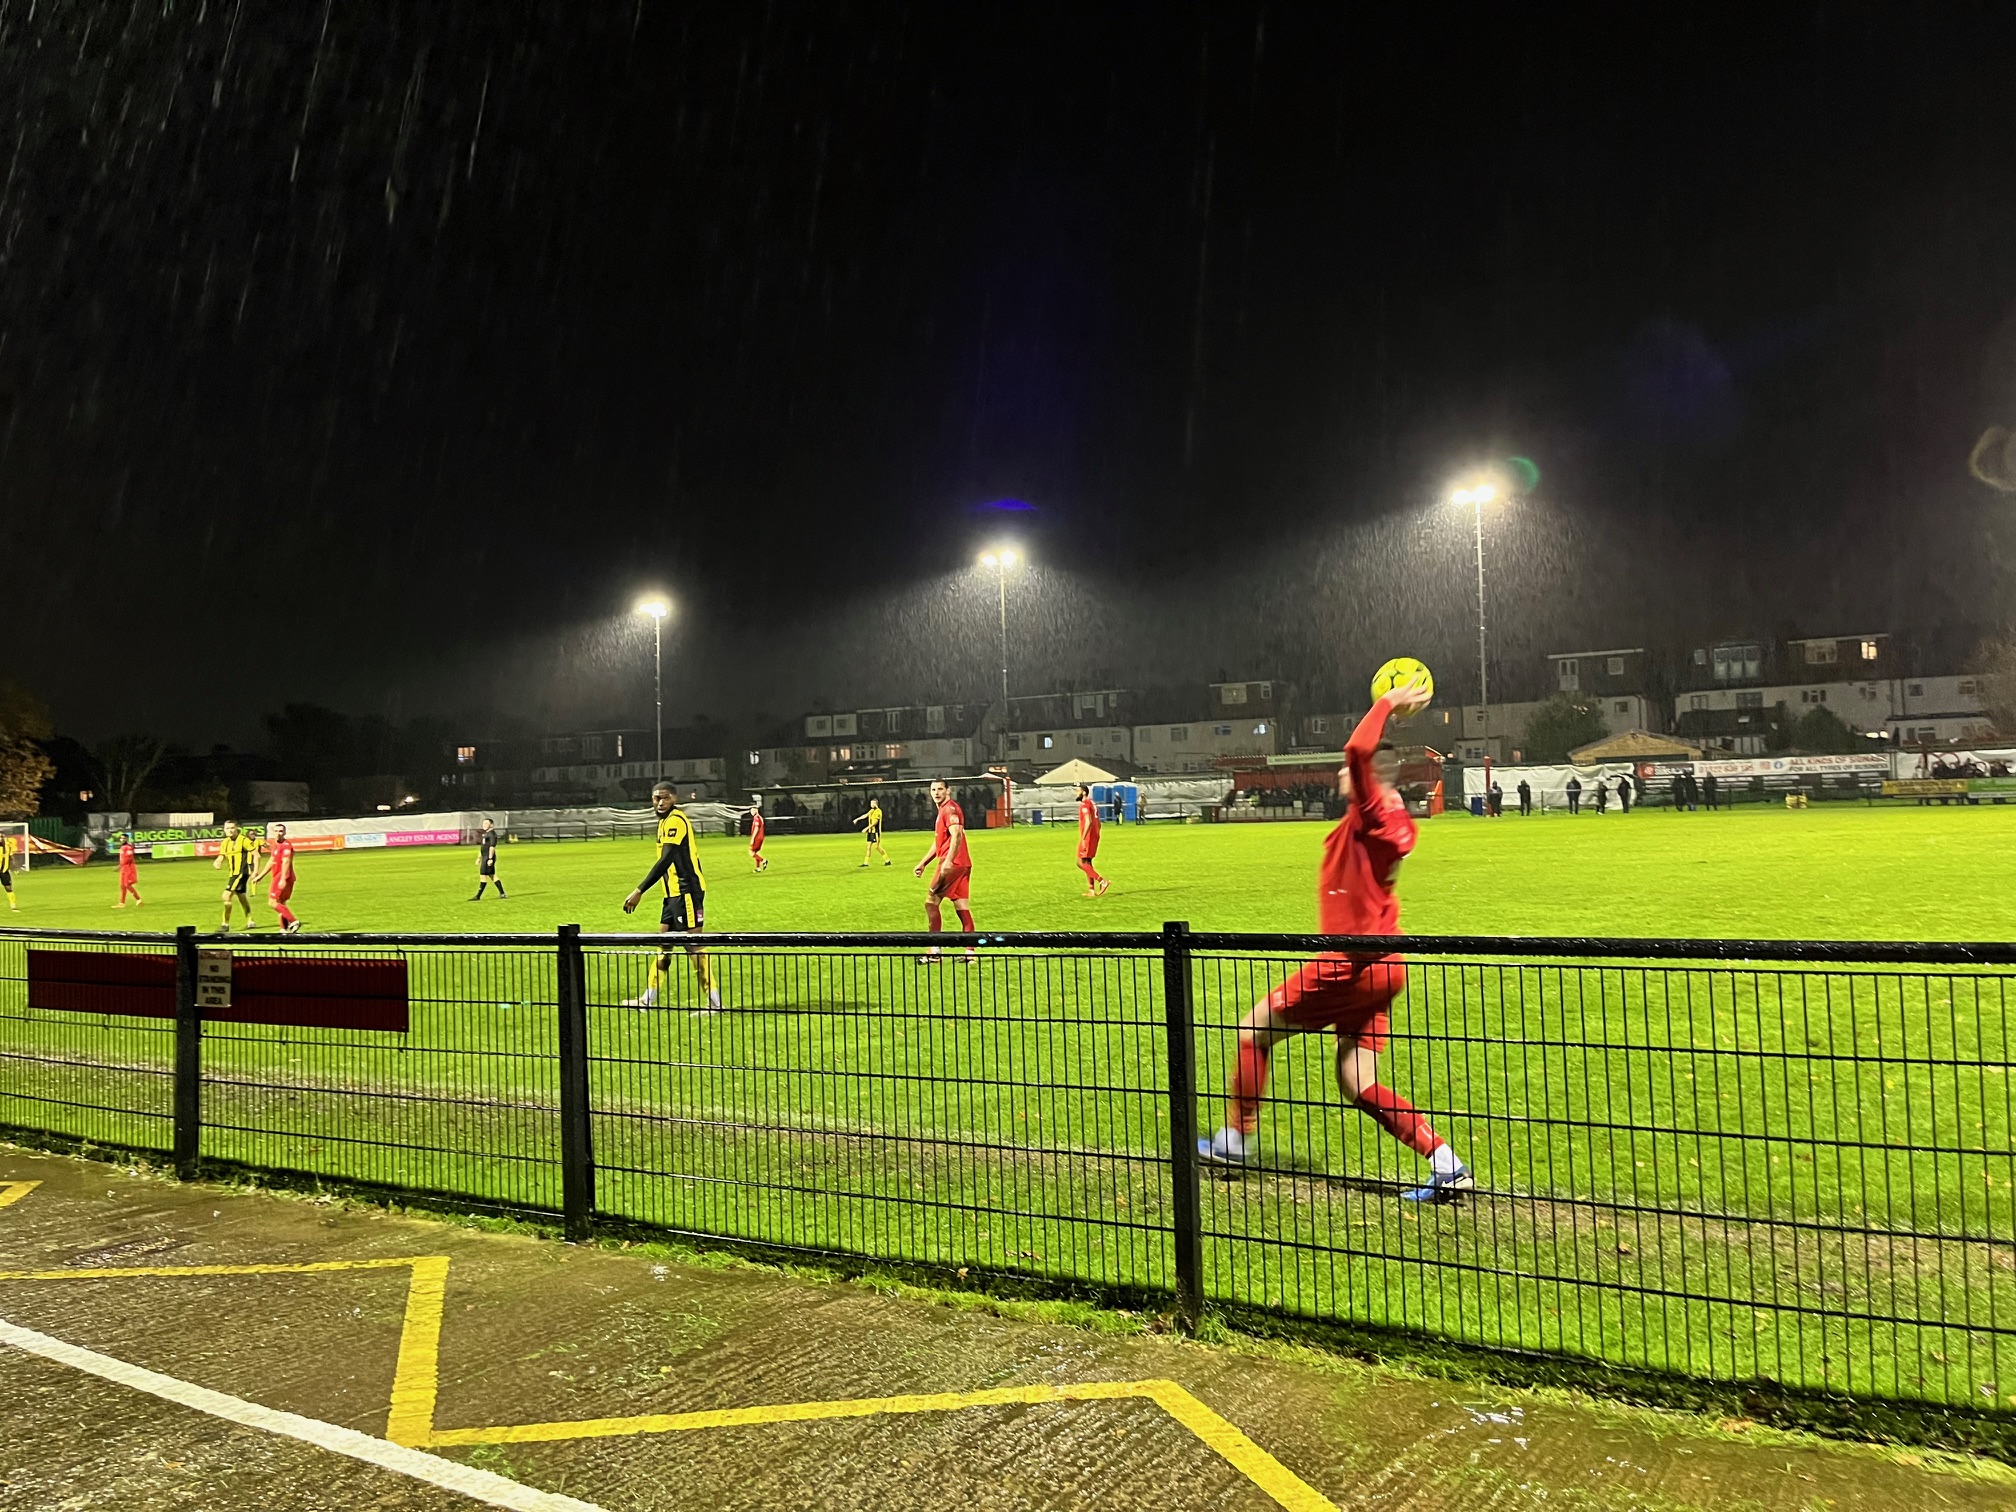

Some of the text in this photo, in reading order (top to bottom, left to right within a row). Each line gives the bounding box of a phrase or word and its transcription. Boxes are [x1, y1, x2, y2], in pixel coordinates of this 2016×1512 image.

[1790, 758, 1805, 766] ALL
[413, 834, 435, 842] ESTATE
[436, 833, 460, 841] AGENTS
[209, 965, 219, 973] NO
